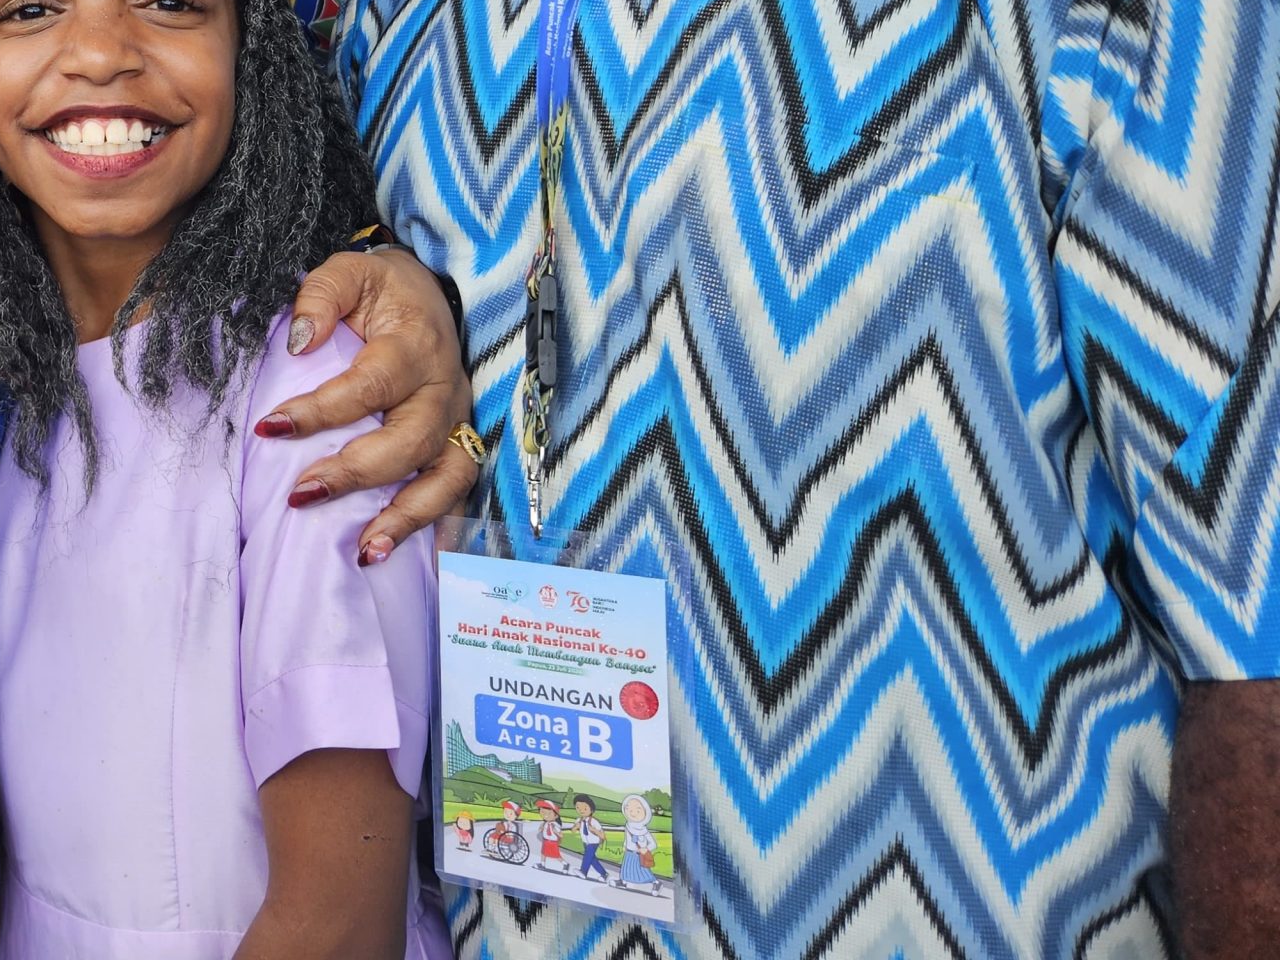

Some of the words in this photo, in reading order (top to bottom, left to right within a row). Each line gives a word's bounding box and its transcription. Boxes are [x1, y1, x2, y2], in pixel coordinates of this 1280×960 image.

[546, 1, 555, 32] Puncak
[458, 622, 488, 636] Hari
[492, 626, 529, 643] Anak
[533, 634, 595, 653] Nasional
[599, 645, 646, 660] Ke-40
[500, 614, 542, 631] Acara
[546, 621, 601, 639] Puncak
[527, 645, 601, 667] Membangun
[489, 676, 613, 711] UNDANGAN
[497, 701, 568, 736] Zona
[578, 716, 613, 761] B
[498, 728, 550, 752] Area
[560, 738, 572, 755] 2
